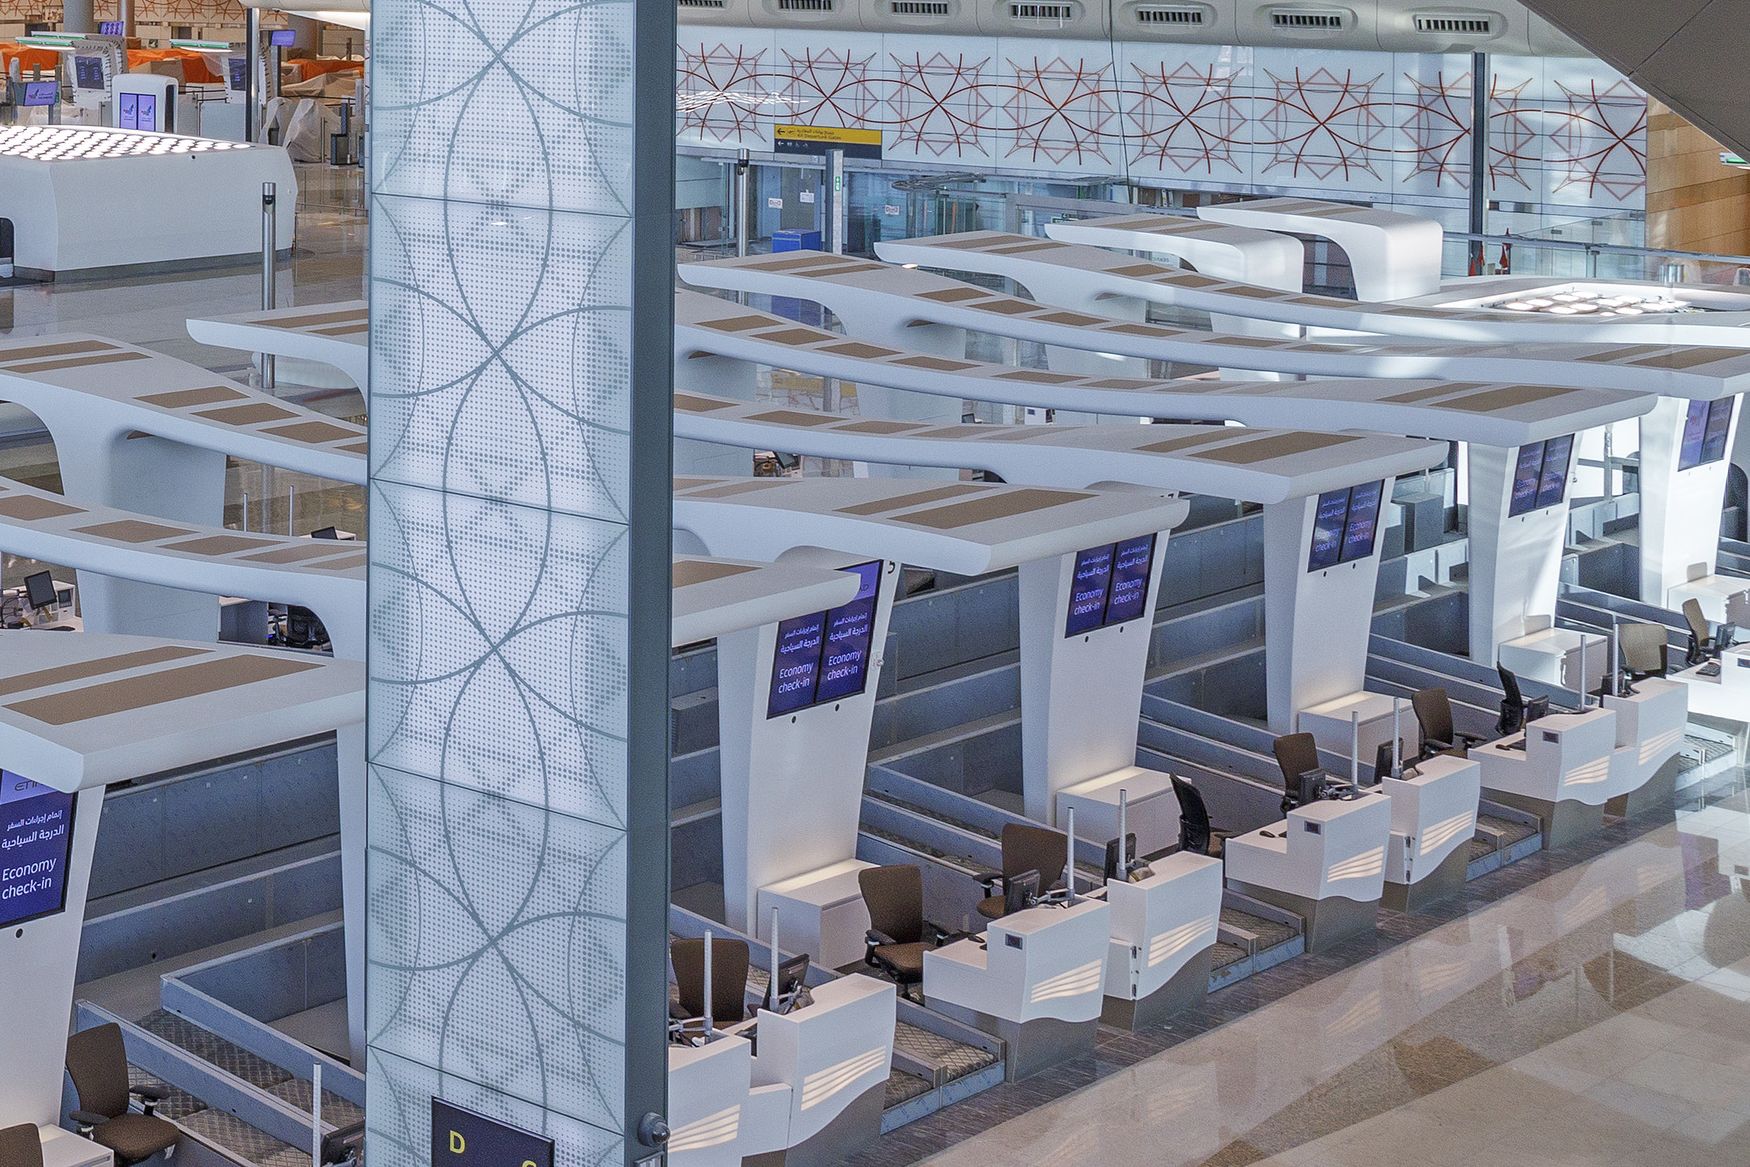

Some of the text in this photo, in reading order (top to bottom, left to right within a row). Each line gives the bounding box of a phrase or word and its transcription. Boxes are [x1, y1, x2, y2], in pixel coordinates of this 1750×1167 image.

[1115, 578, 1143, 591] Economy
[1075, 589, 1104, 602] Economy
[1114, 591, 1139, 604] check-in
[1074, 601, 1100, 615] check-in
[828, 650, 862, 666] Economy
[779, 662, 814, 678] Economy
[827, 665, 858, 680] check-in
[778, 677, 809, 693] check-in
[2, 824, 65, 851] الدرجة السياحية
[2, 858, 57, 881] Economy
[2, 877, 52, 900] check-in
[450, 1129, 466, 1154] D
